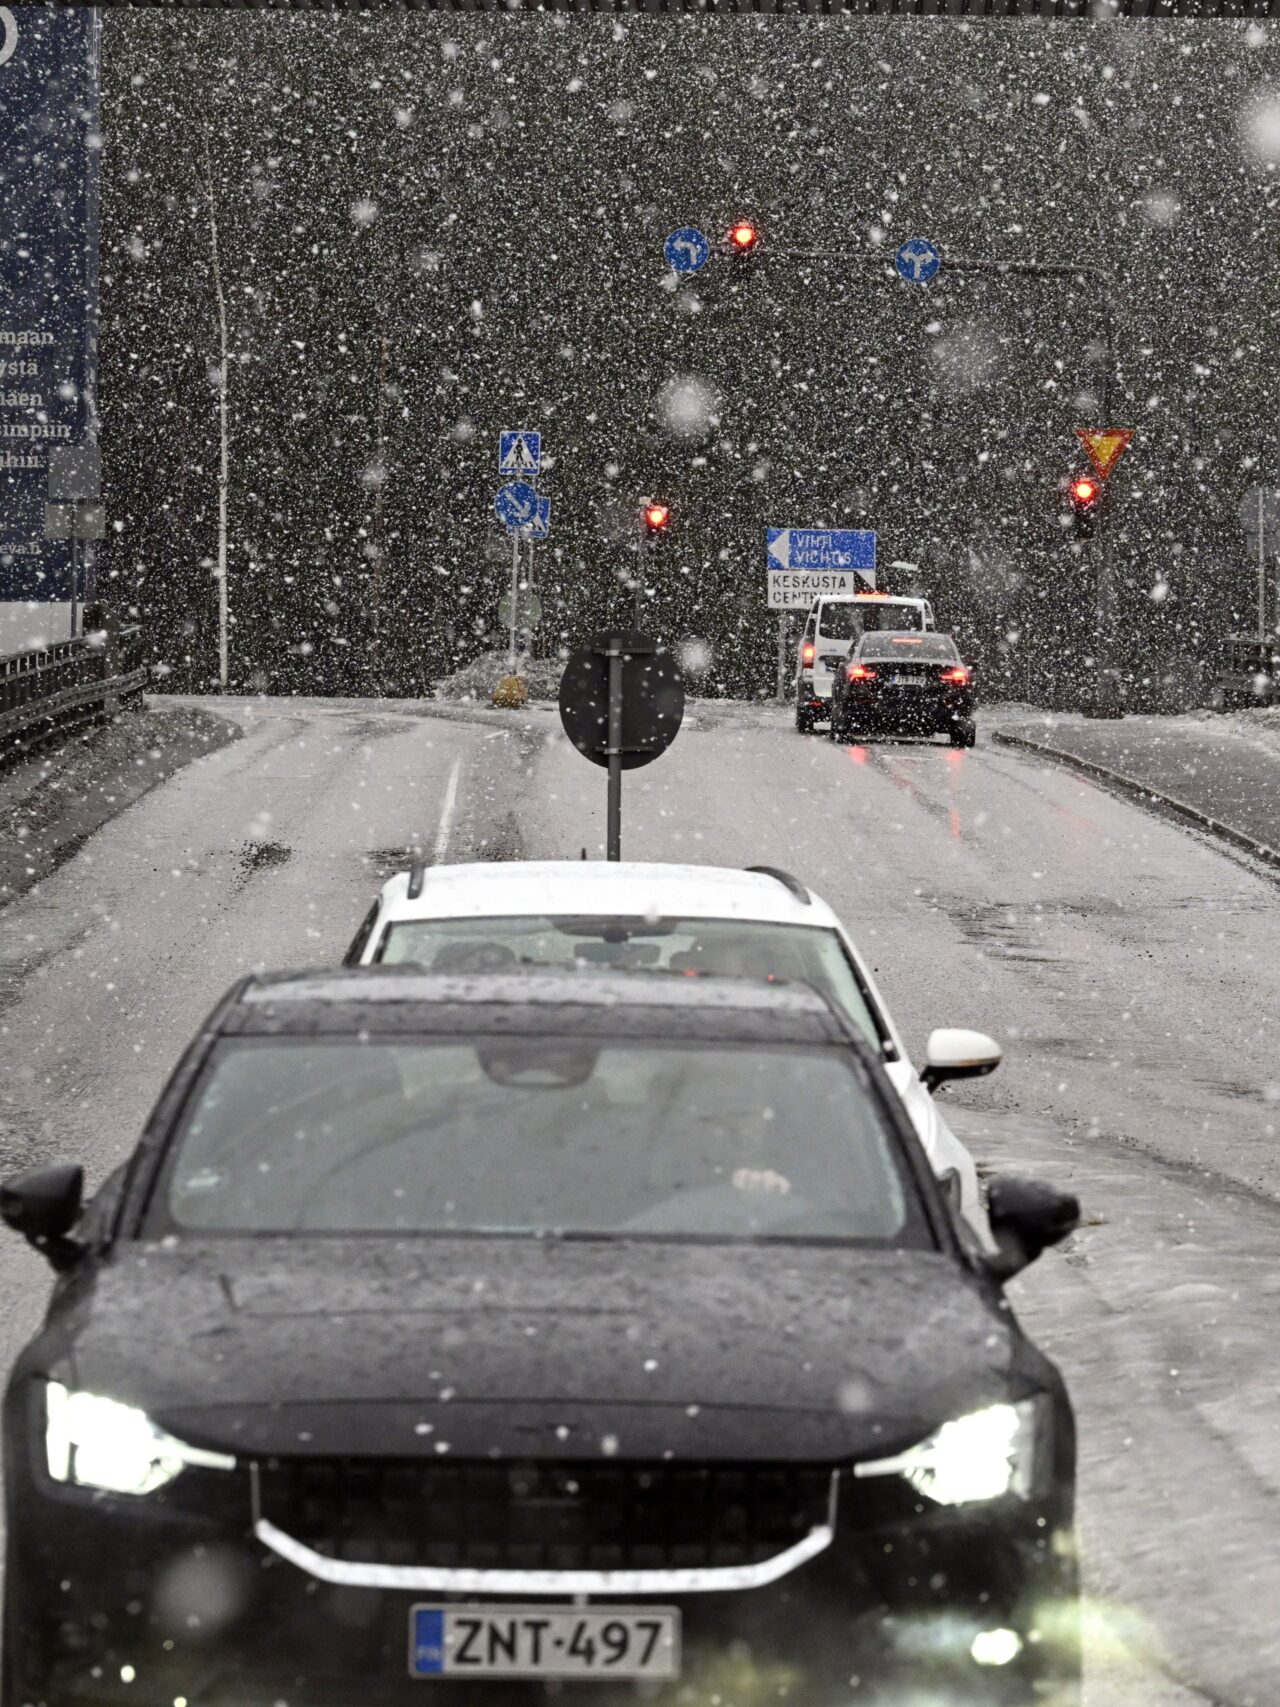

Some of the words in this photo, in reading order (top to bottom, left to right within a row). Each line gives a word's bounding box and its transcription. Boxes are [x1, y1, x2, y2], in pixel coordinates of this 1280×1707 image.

[796, 534, 832, 548] VIHTI
[795, 550, 852, 565] VICHTIS
[772, 575, 846, 588] KESKUSTA
[454, 1619, 662, 1666] ZNT-497
